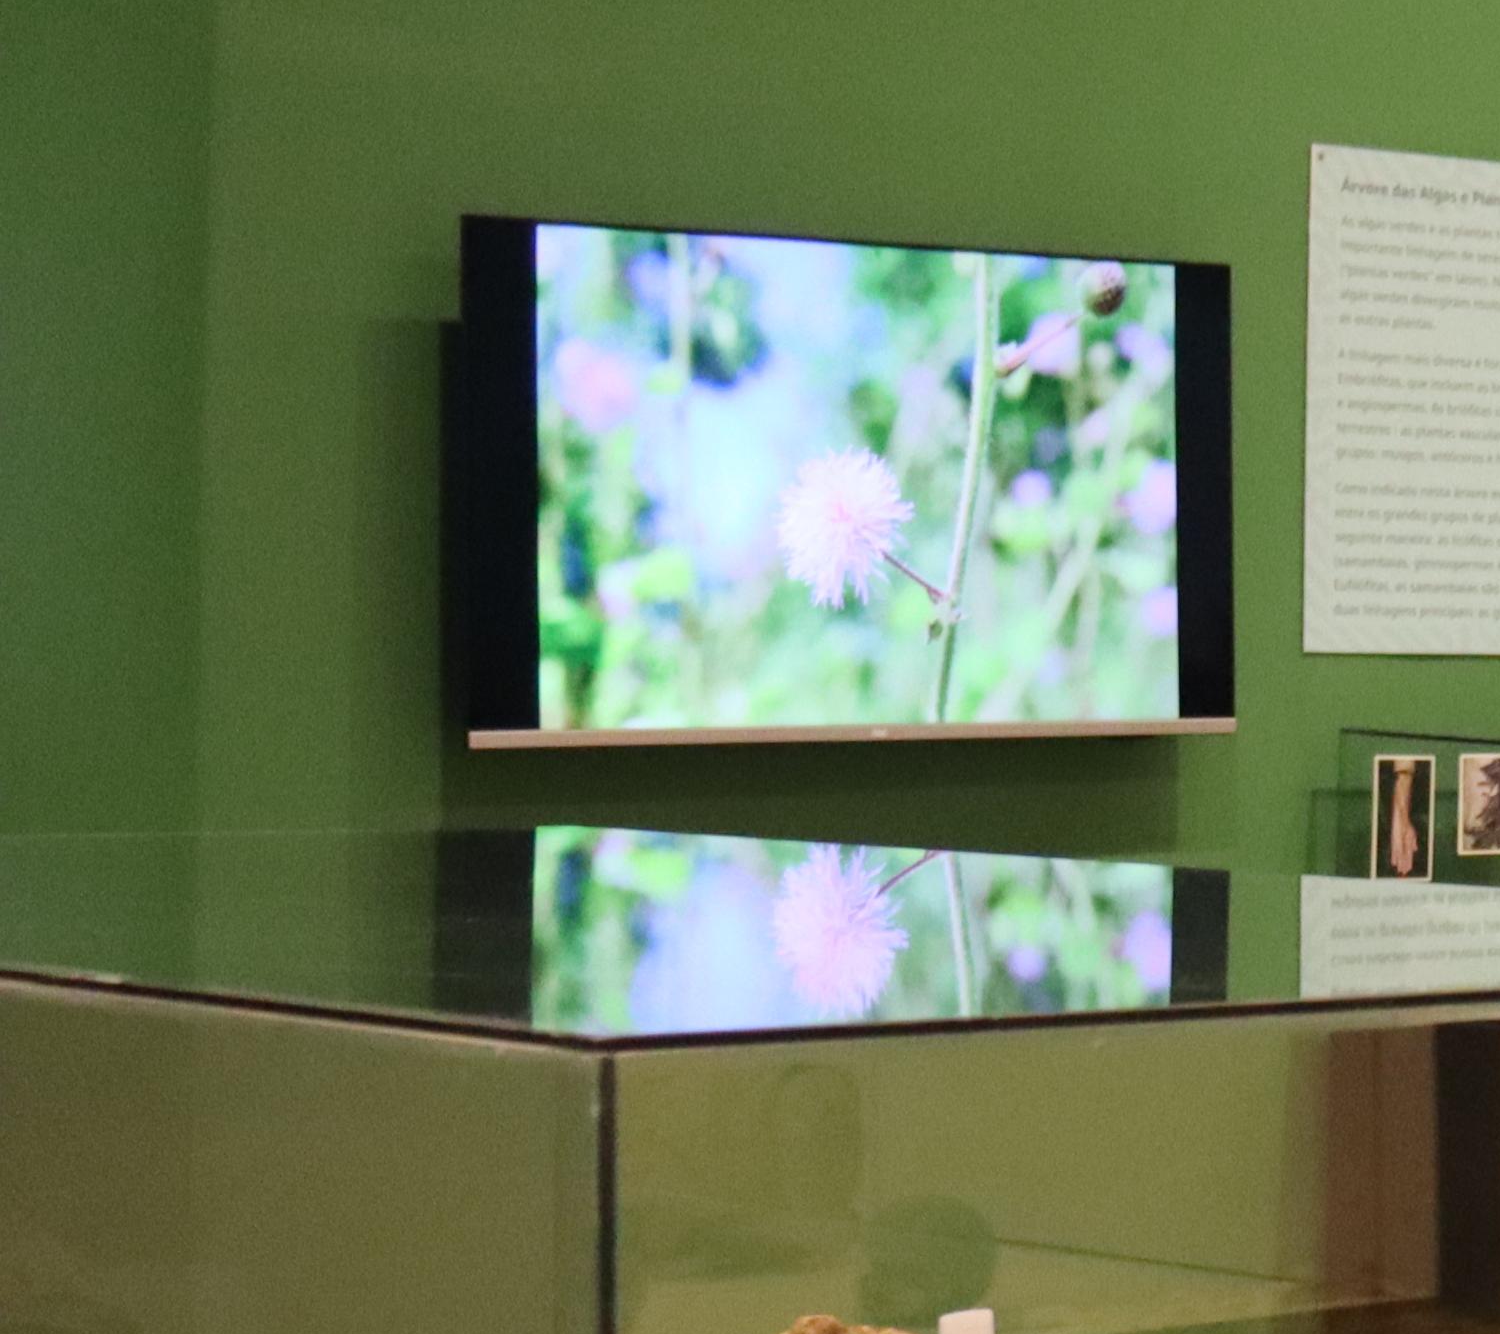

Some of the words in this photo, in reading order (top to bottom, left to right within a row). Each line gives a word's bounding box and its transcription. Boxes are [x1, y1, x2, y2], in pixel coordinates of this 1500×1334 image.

[1339, 174, 1388, 196] Árvore
[1391, 182, 1416, 199] das
[1418, 185, 1457, 207] Algas
[1460, 192, 1469, 204] e
